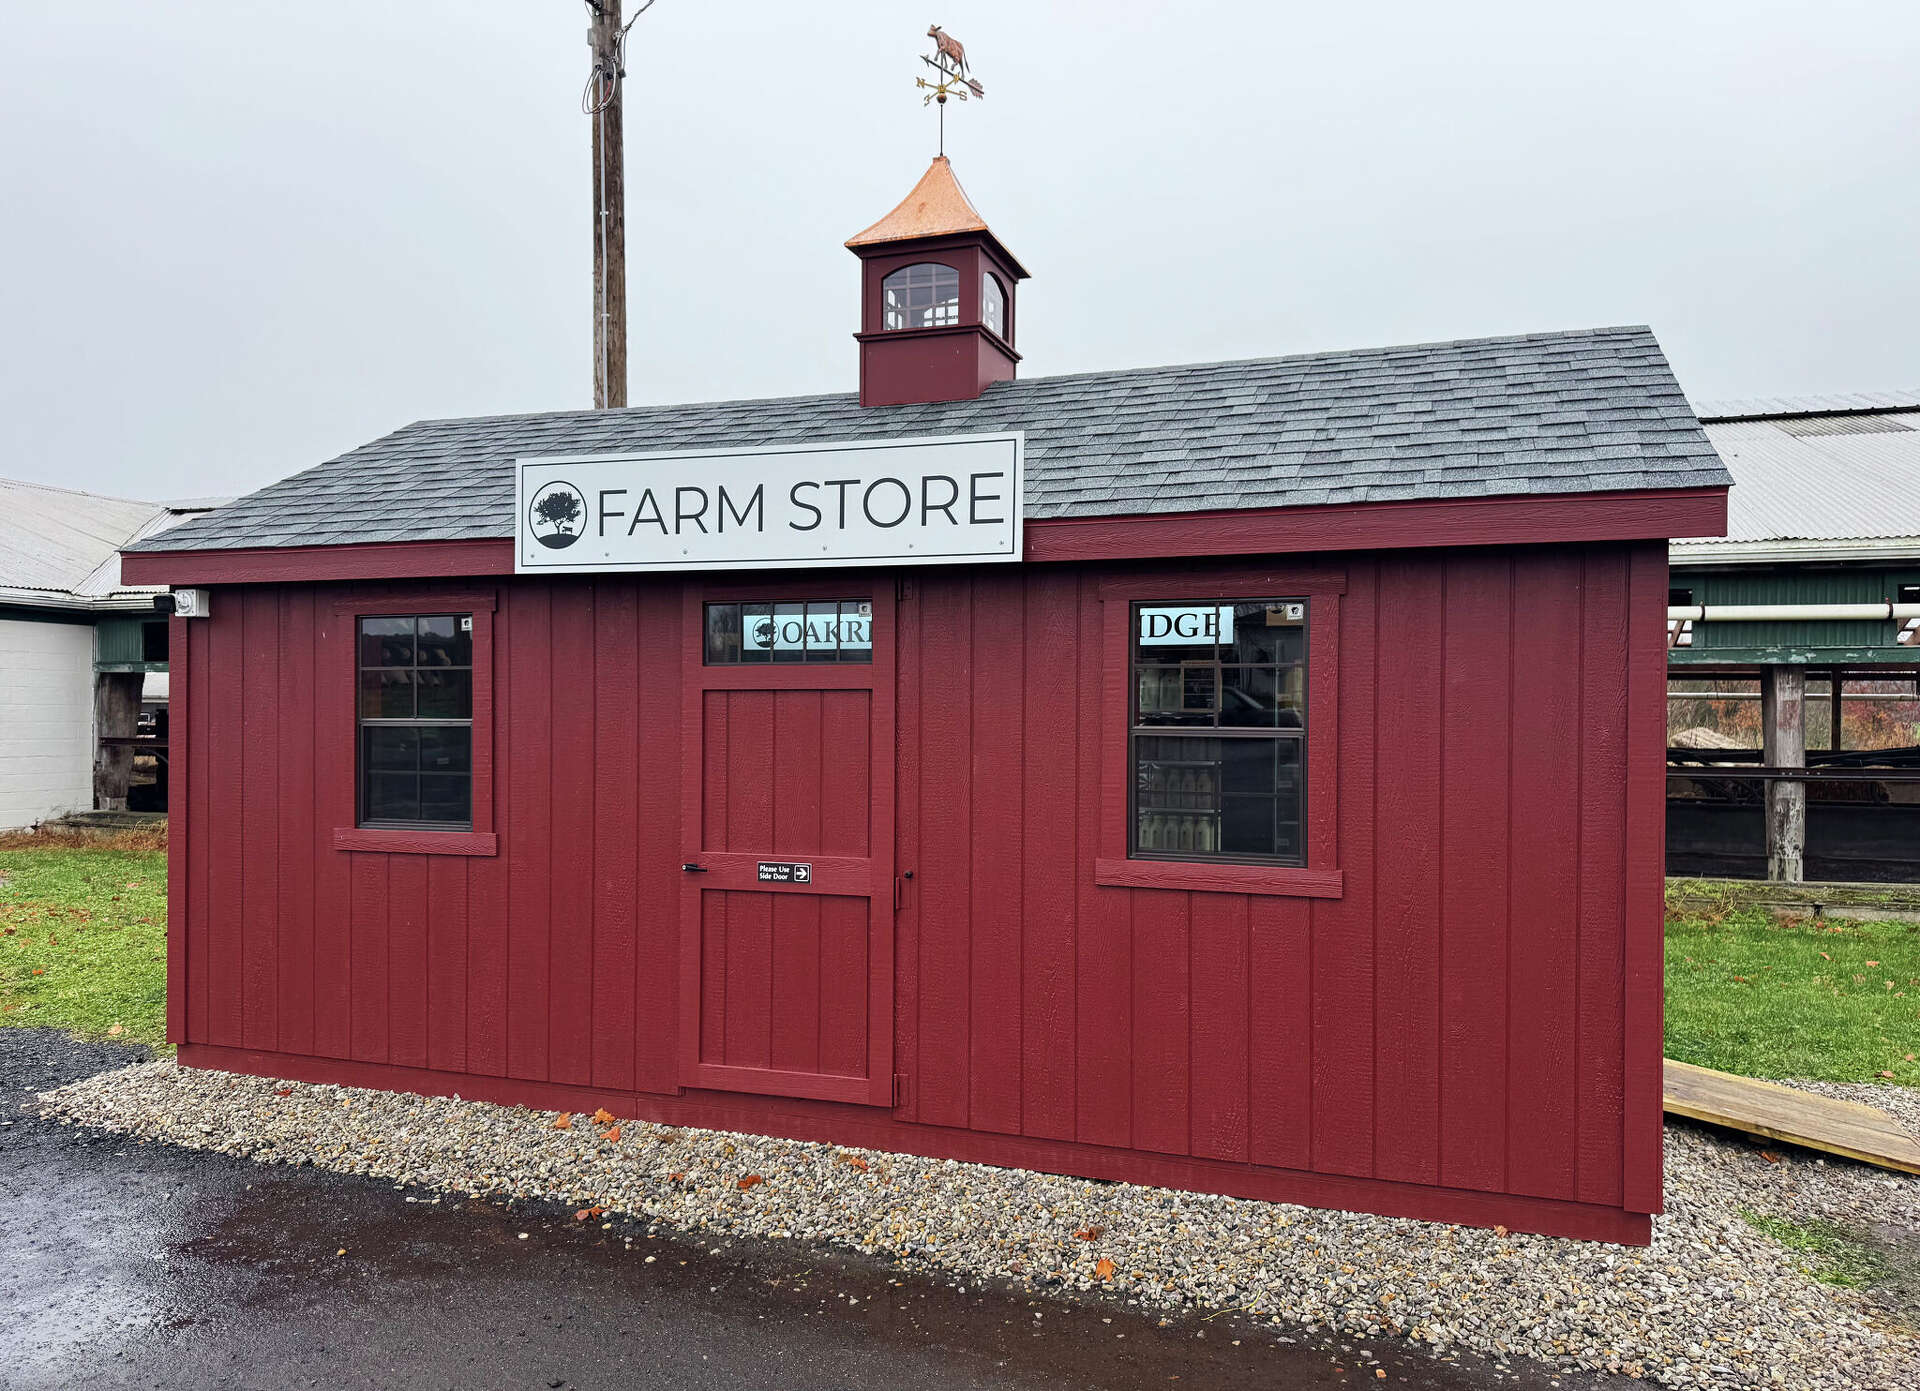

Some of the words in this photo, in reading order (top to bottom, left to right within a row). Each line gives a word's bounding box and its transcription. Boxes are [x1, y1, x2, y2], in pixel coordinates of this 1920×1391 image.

[598, 483, 765, 537] FARM
[788, 471, 1005, 532] STORE
[759, 864, 778, 873] Please
[778, 865, 790, 873] Use
[759, 872, 772, 880] Side
[772, 872, 789, 880] Door
